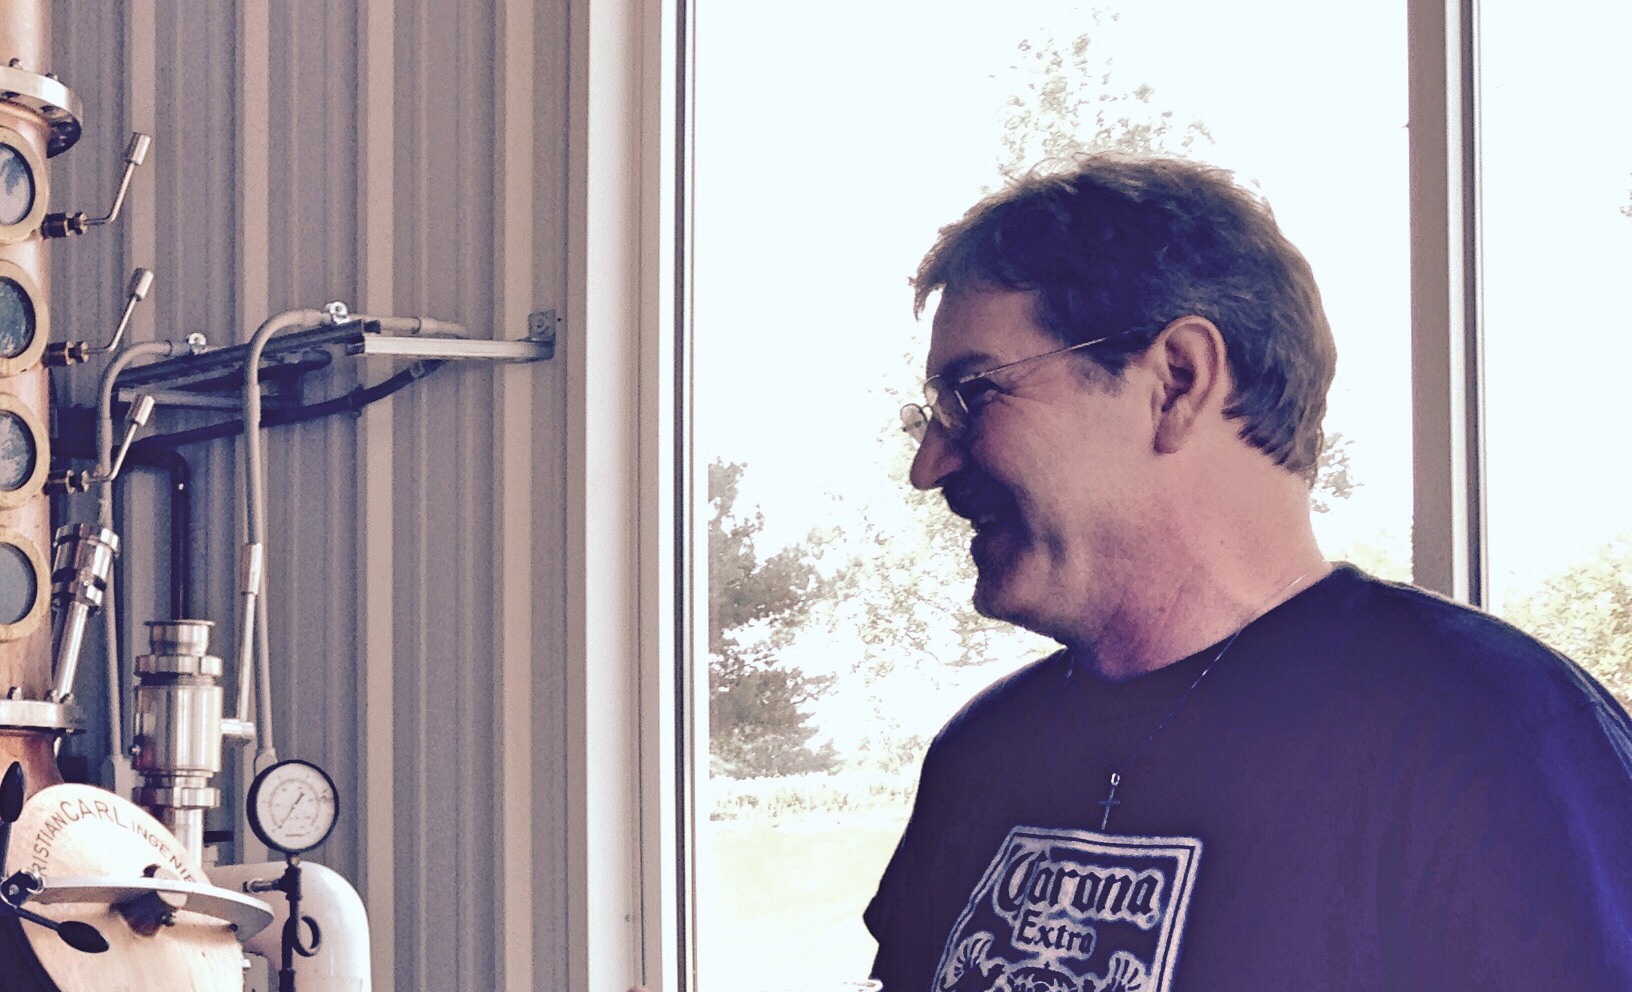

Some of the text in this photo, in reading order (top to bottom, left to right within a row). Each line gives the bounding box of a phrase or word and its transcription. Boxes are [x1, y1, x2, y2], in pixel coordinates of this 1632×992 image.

[32, 799, 196, 883] RISTIAN CARL INGENIE
[997, 850, 1159, 916] Corona
[1018, 908, 1094, 954] Extra
